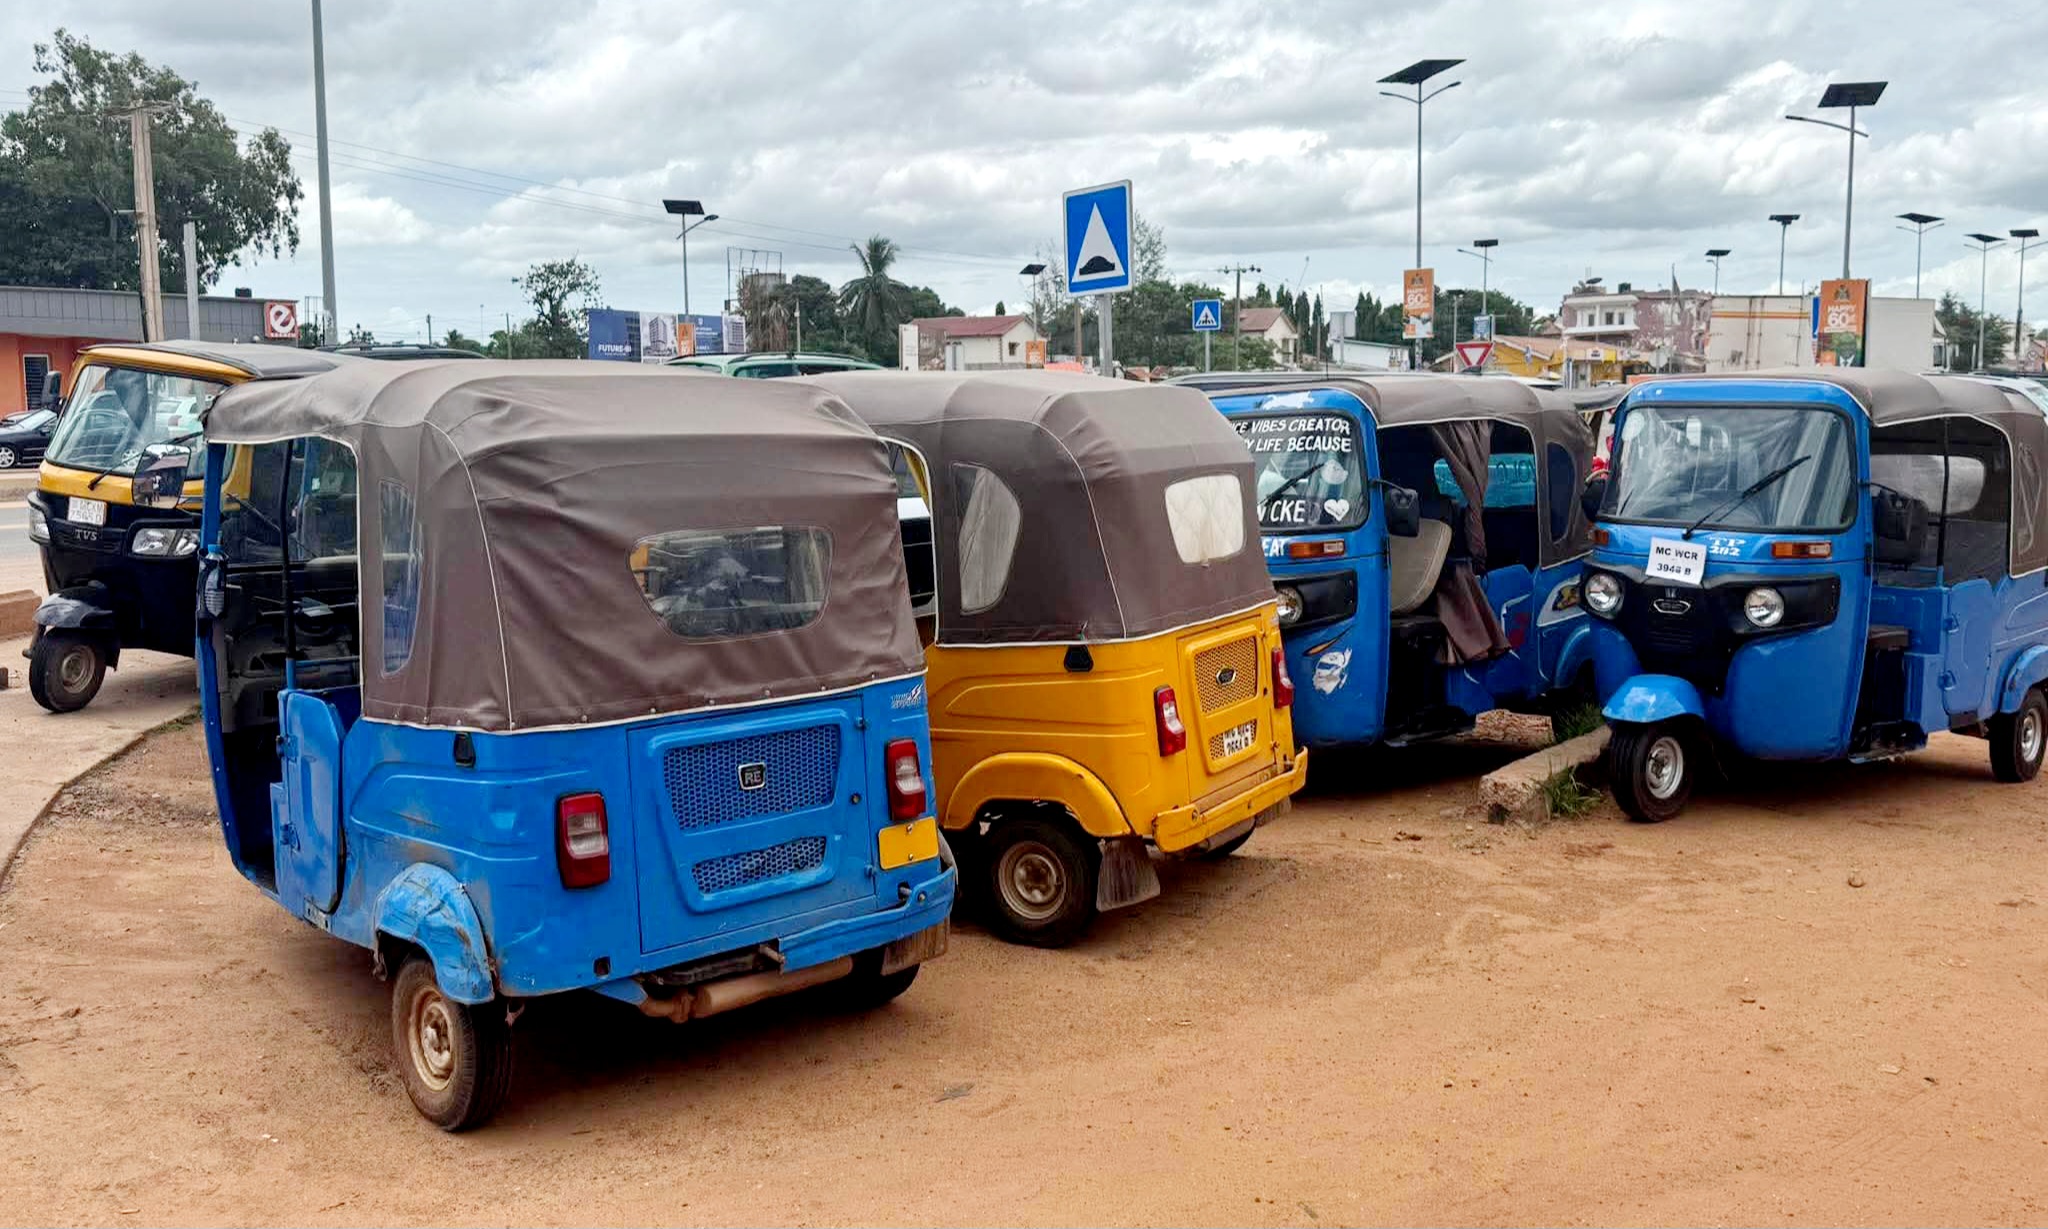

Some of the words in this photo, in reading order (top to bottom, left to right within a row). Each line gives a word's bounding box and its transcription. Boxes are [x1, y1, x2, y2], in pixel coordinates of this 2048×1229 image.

[1251, 420, 1286, 434] VIBES
[1288, 418, 1350, 435] CREATOR
[1255, 438, 1282, 452] LIFE
[1287, 435, 1352, 452] BECAUSE
[75, 529, 98, 541] TVS
[1655, 546, 1671, 556] MC
[1675, 549, 1698, 560] WCR
[1684, 567, 1691, 575] B
[744, 770, 761, 785] RE
